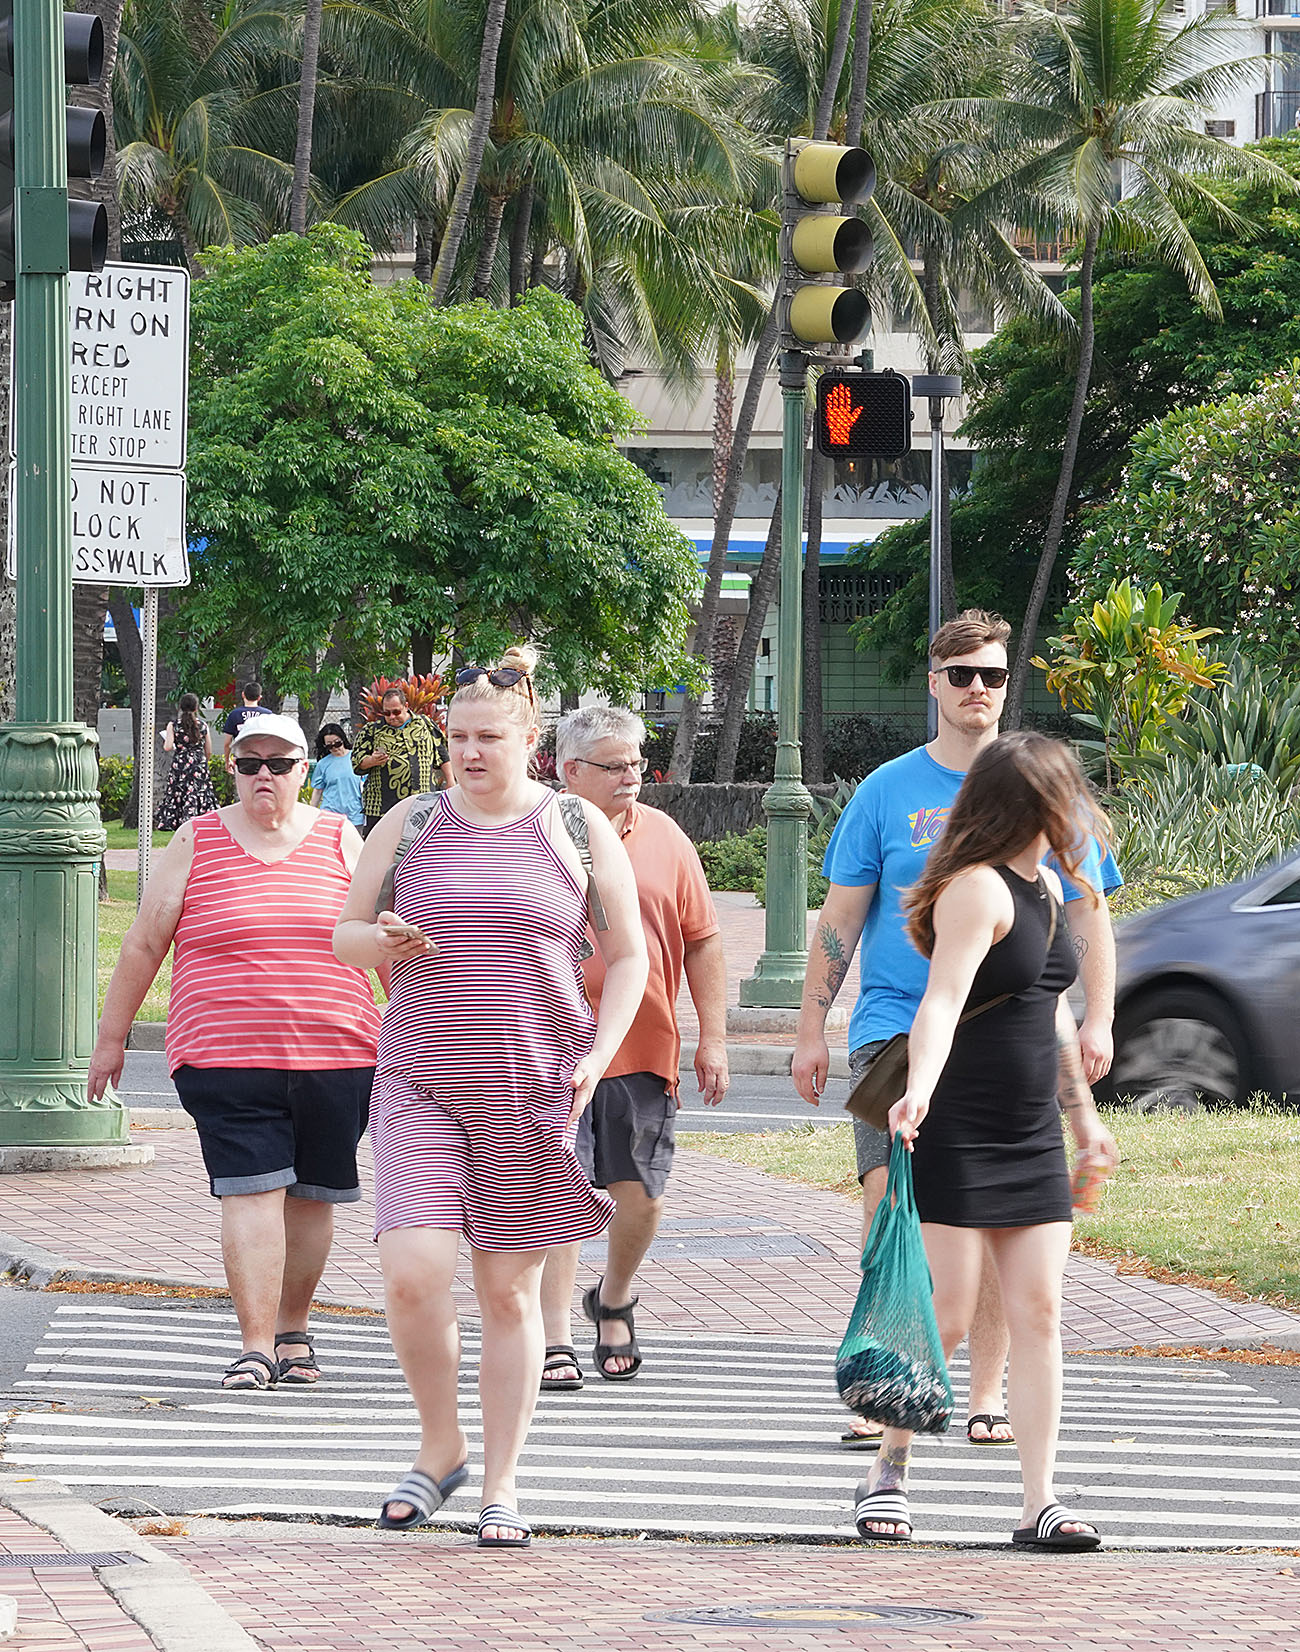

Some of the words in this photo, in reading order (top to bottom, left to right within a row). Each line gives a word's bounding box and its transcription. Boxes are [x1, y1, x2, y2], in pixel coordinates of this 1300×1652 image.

[85, 274, 173, 303] RIGHT
[69, 305, 115, 332] RN
[130, 312, 168, 337] ON
[72, 342, 130, 367] RED
[71, 374, 128, 398] EXCEPT
[78, 404, 123, 427] RIGHT
[133, 408, 172, 431] LANE
[71, 433, 98, 455] TER
[108, 436, 146, 458] STOP
[100, 479, 150, 506] NOT
[73, 511, 143, 540] LOCK
[72, 546, 168, 576] SSWALK
